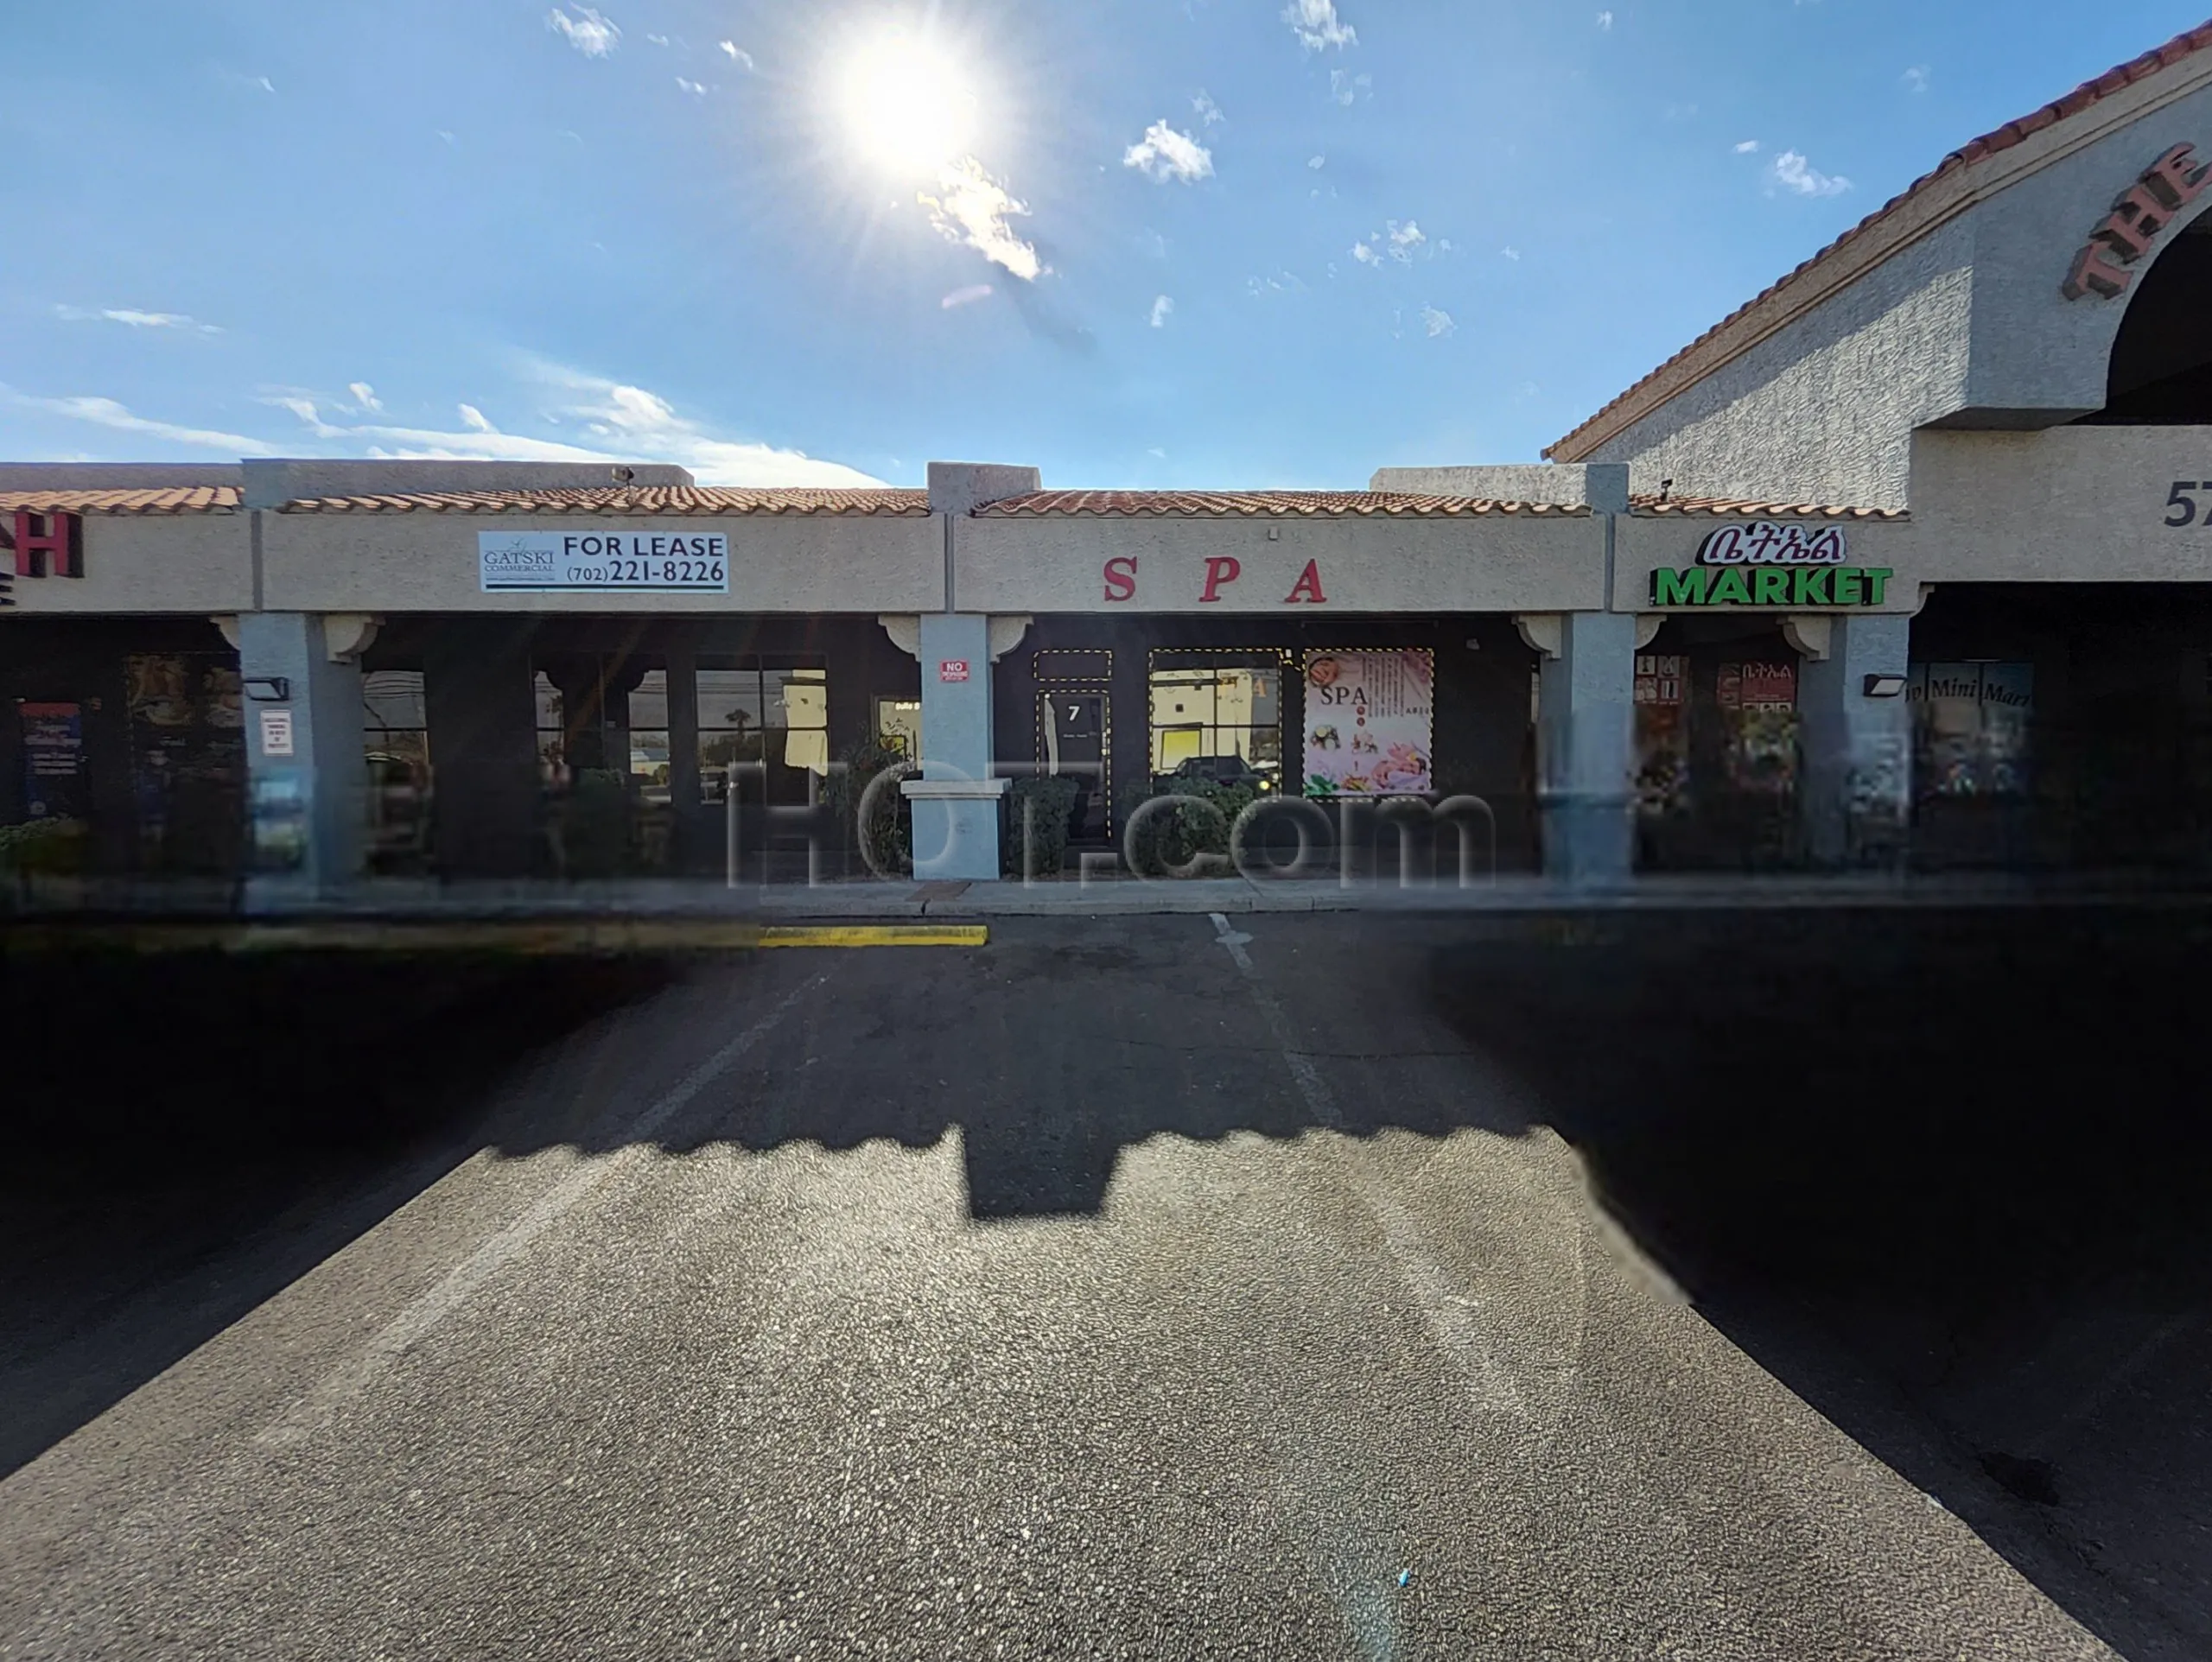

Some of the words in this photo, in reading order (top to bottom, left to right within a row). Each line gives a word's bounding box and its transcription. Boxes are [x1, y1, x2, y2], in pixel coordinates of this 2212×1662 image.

[2062, 141, 2212, 301] THE
[563, 536, 623, 555] FOR
[633, 537, 723, 557] LEASE
[484, 551, 555, 564] GATSKI
[1651, 568, 1893, 605] MARKET
[946, 662, 963, 672] NO
[1320, 686, 1368, 706] SPA
[1931, 677, 1978, 698] Mini
[1068, 705, 1080, 721] 7
